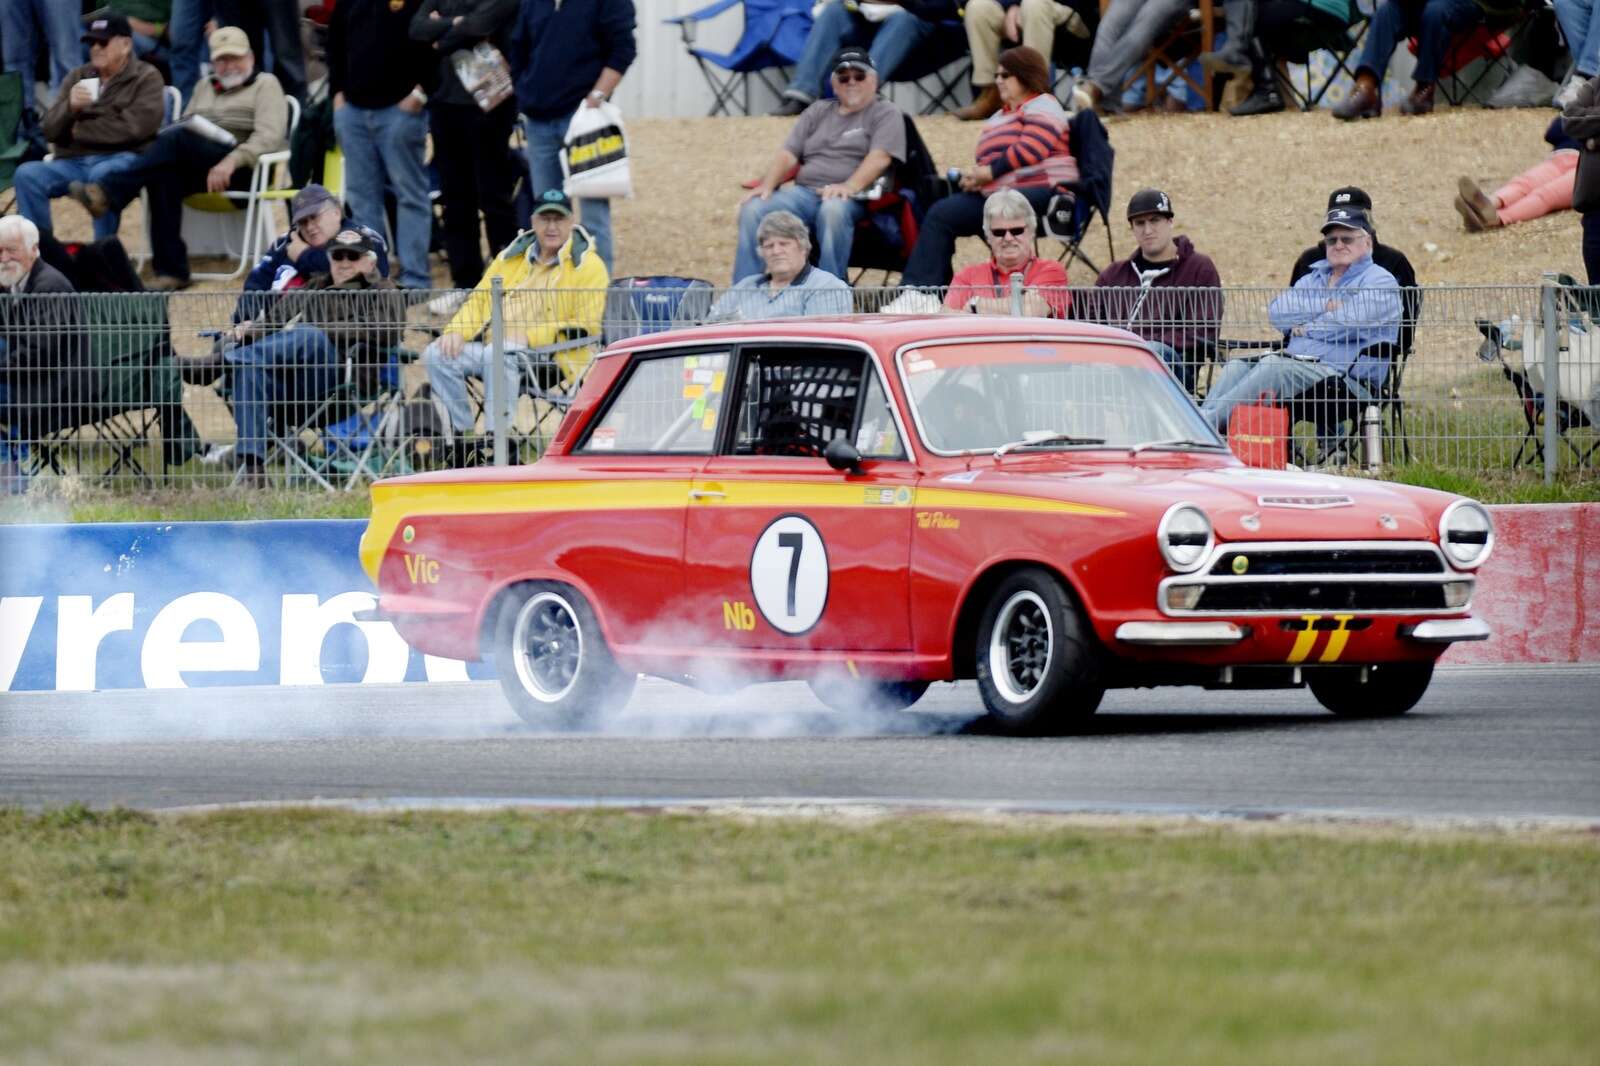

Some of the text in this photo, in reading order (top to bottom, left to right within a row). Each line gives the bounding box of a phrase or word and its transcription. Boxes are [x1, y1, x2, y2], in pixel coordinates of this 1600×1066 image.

[403, 554, 440, 584] Vic
[779, 533, 803, 616] 7
[722, 601, 756, 630] Nb
